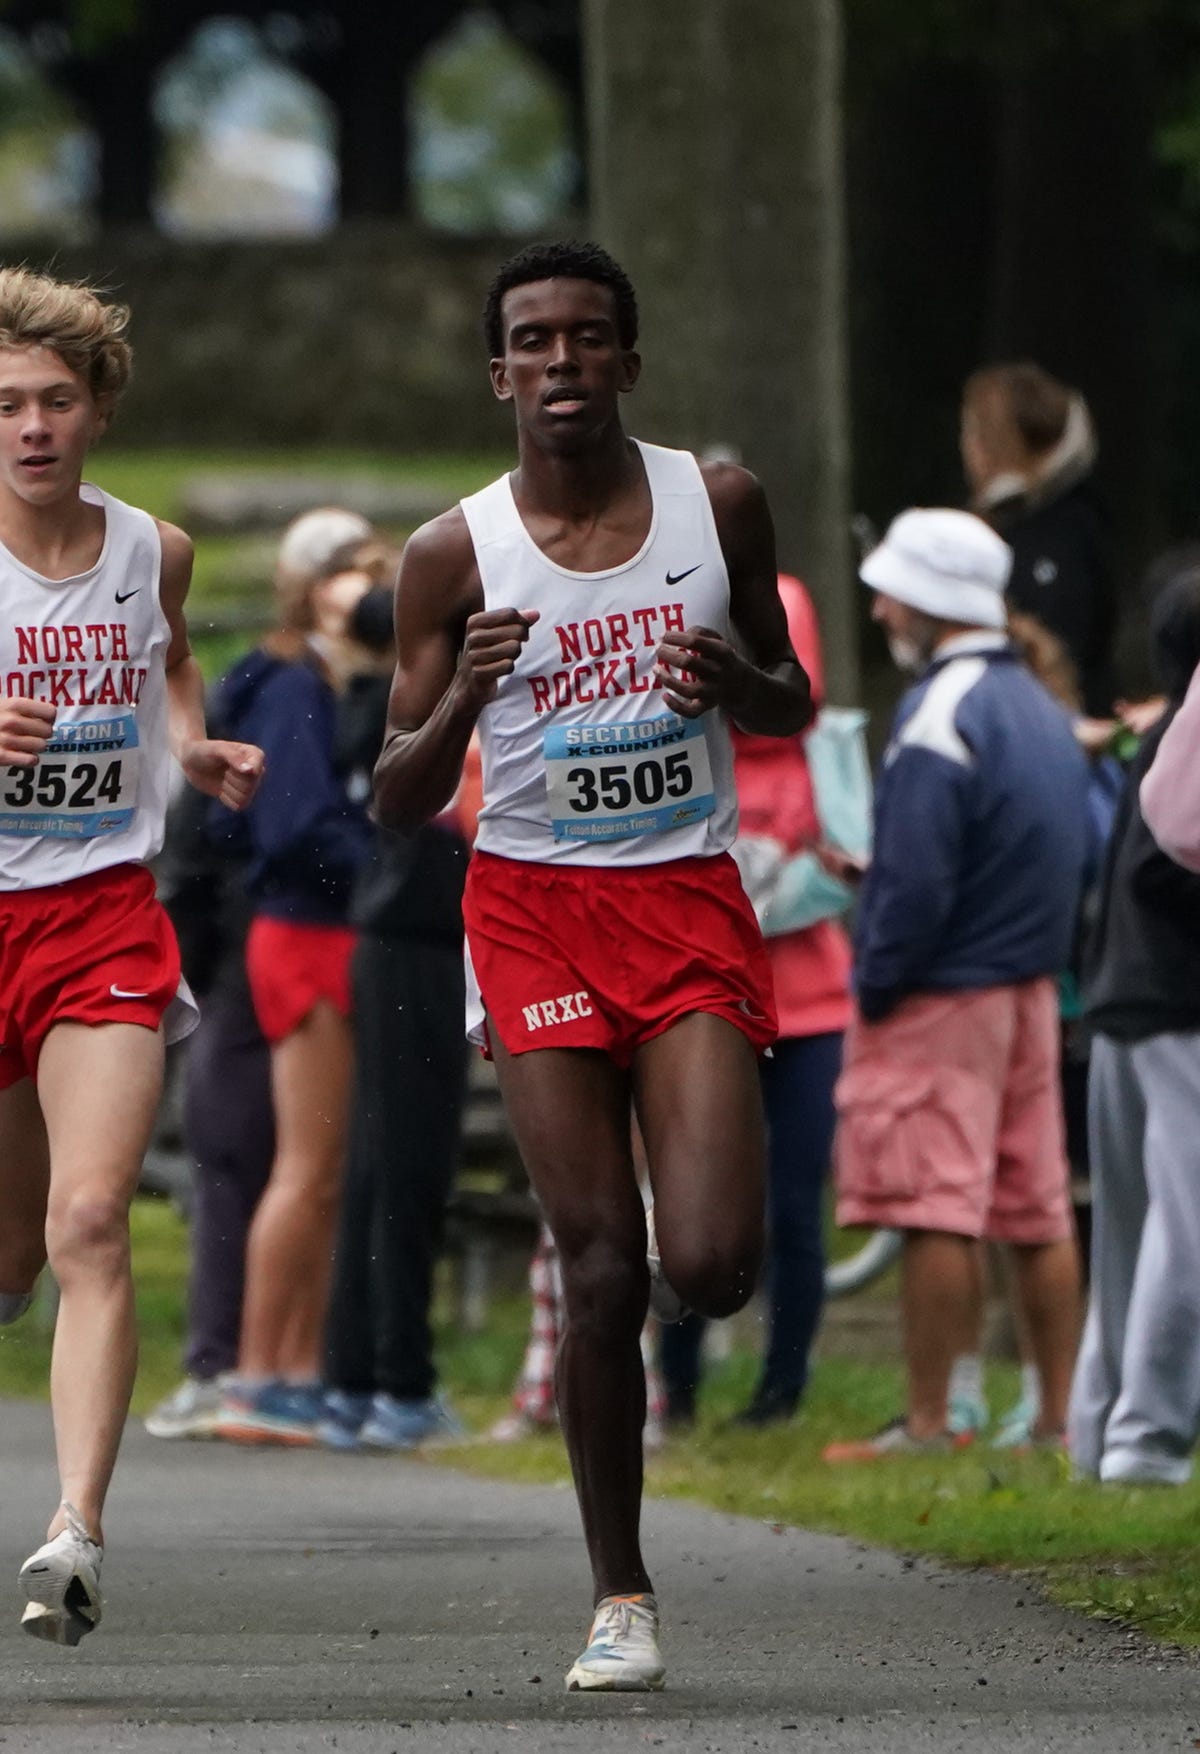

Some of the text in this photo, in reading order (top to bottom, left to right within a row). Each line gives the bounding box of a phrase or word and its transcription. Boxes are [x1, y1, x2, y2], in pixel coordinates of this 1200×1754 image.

[14, 623, 129, 665] NORTH
[554, 603, 685, 664] NORTH
[527, 648, 699, 713] ROCKL
[45, 739, 126, 753] OUNTRY
[48, 723, 112, 741] TION
[566, 718, 668, 745] SECTION
[566, 729, 686, 757] X-COUNTRY
[3, 760, 123, 808] 3524
[566, 750, 693, 813] 3505
[630, 816, 658, 831] Timing
[521, 991, 593, 1031] NRXC
